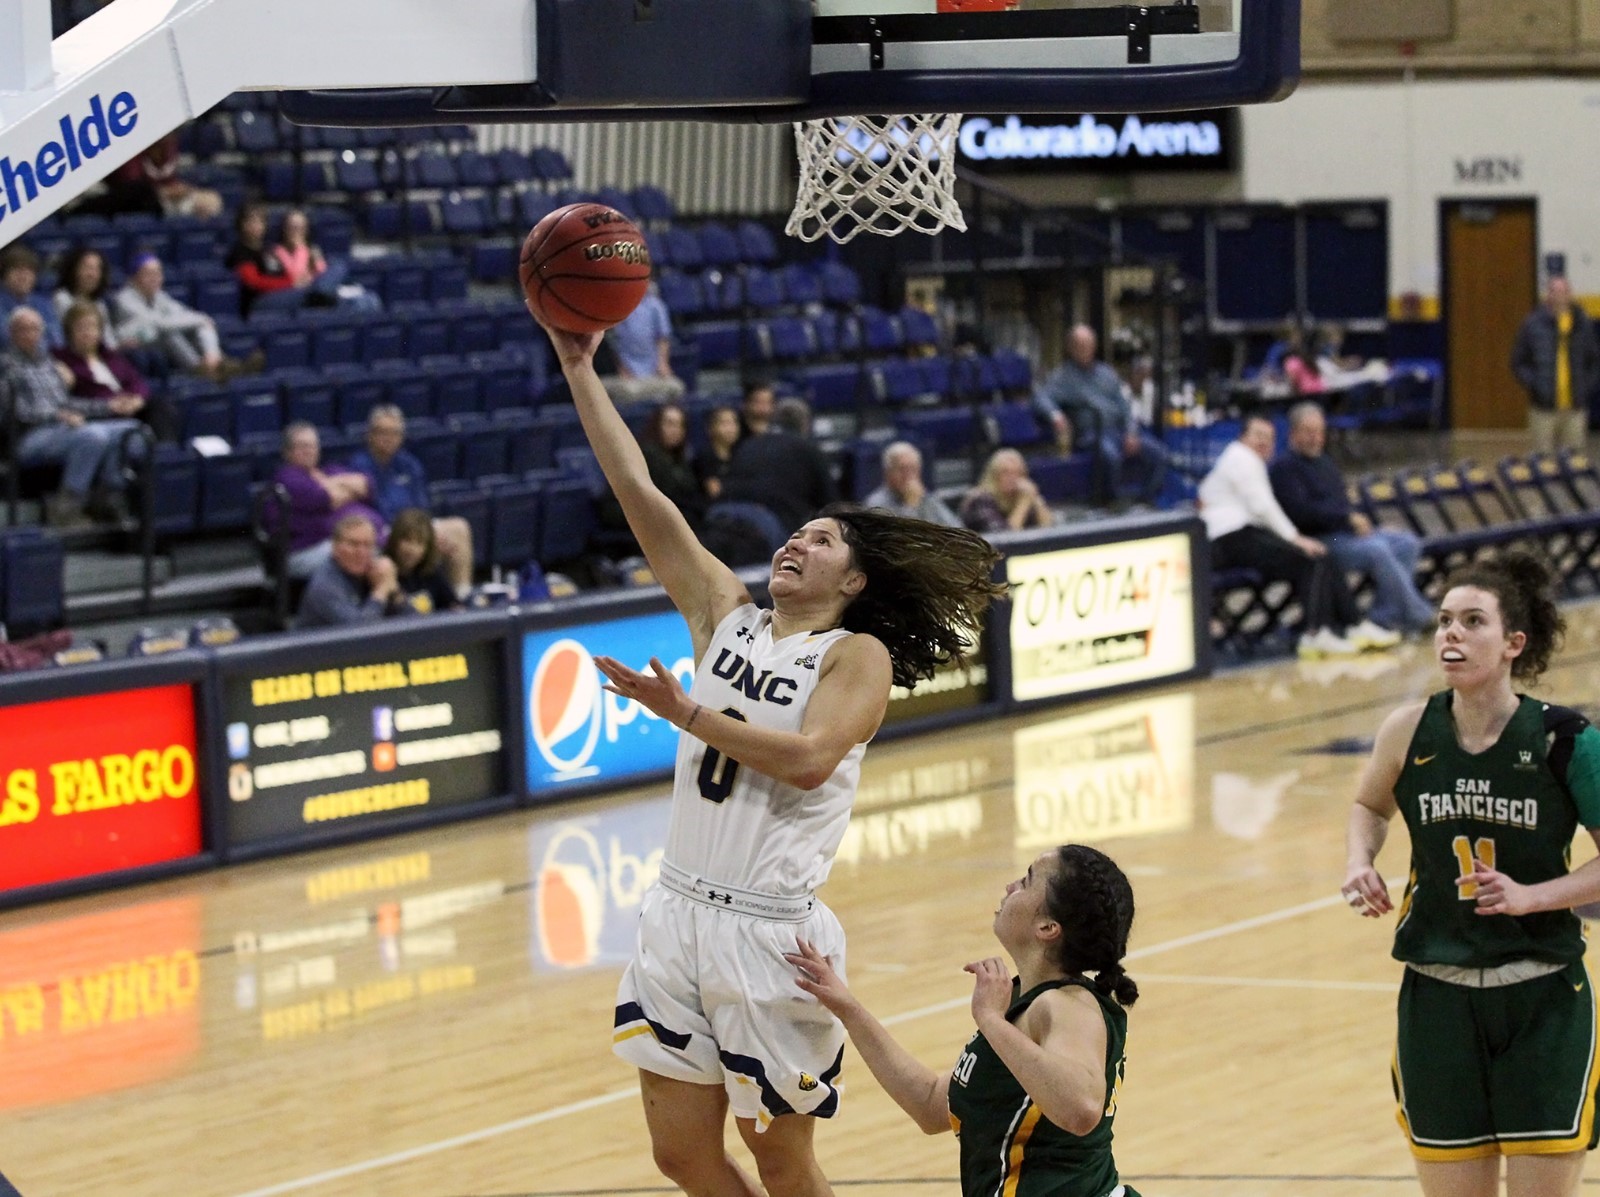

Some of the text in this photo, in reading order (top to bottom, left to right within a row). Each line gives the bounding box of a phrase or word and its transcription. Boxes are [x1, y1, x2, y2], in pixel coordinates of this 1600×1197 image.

[958, 114, 1118, 160] Colorado
[1117, 114, 1222, 157] Arena
[1454, 159, 1521, 184] MEN
[1009, 566, 1138, 628] TOYOTA
[711, 647, 798, 706] UNC
[49, 744, 195, 816] FARGO
[1455, 778, 1491, 794] SAN
[1418, 792, 1538, 830] FRANCISCO
